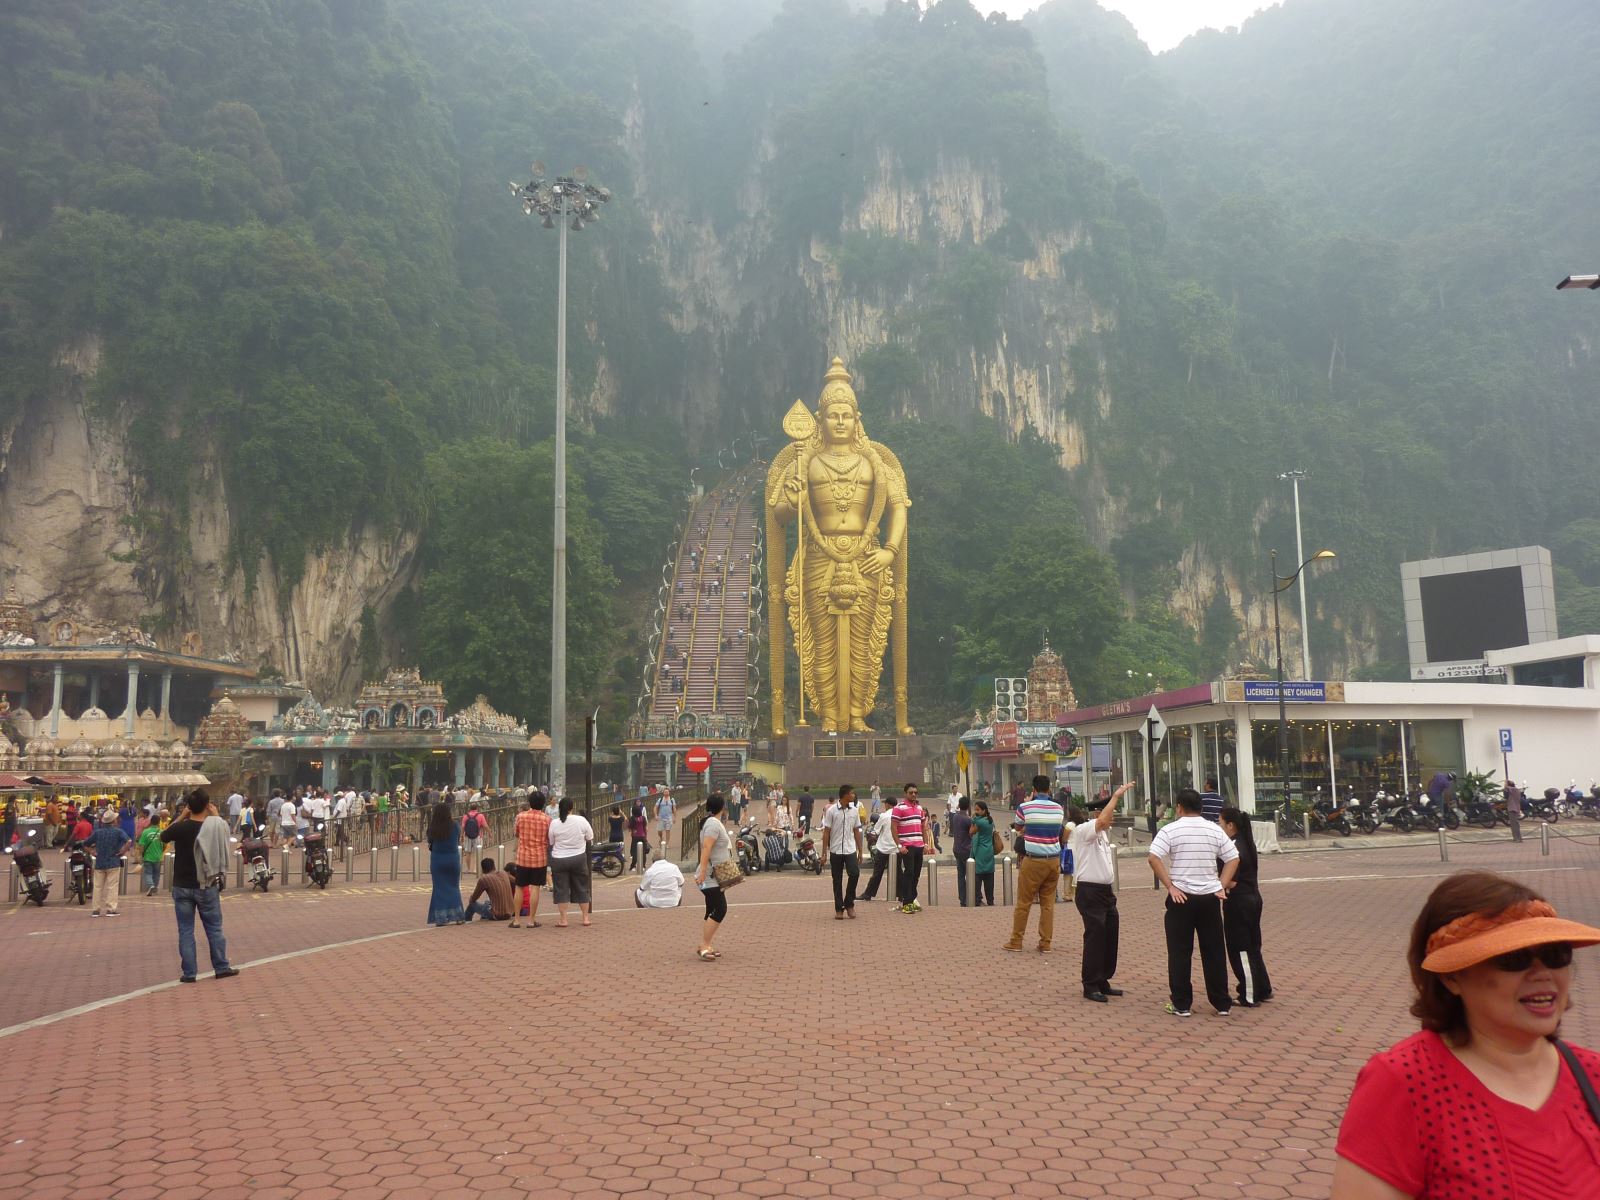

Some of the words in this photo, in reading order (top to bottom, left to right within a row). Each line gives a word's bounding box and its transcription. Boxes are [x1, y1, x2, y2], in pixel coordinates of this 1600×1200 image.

[1246, 688, 1274, 696] LICENSED
[1275, 688, 1295, 697] MNEY
[1296, 688, 1324, 697] CHANGER
[1501, 731, 1510, 745] P
